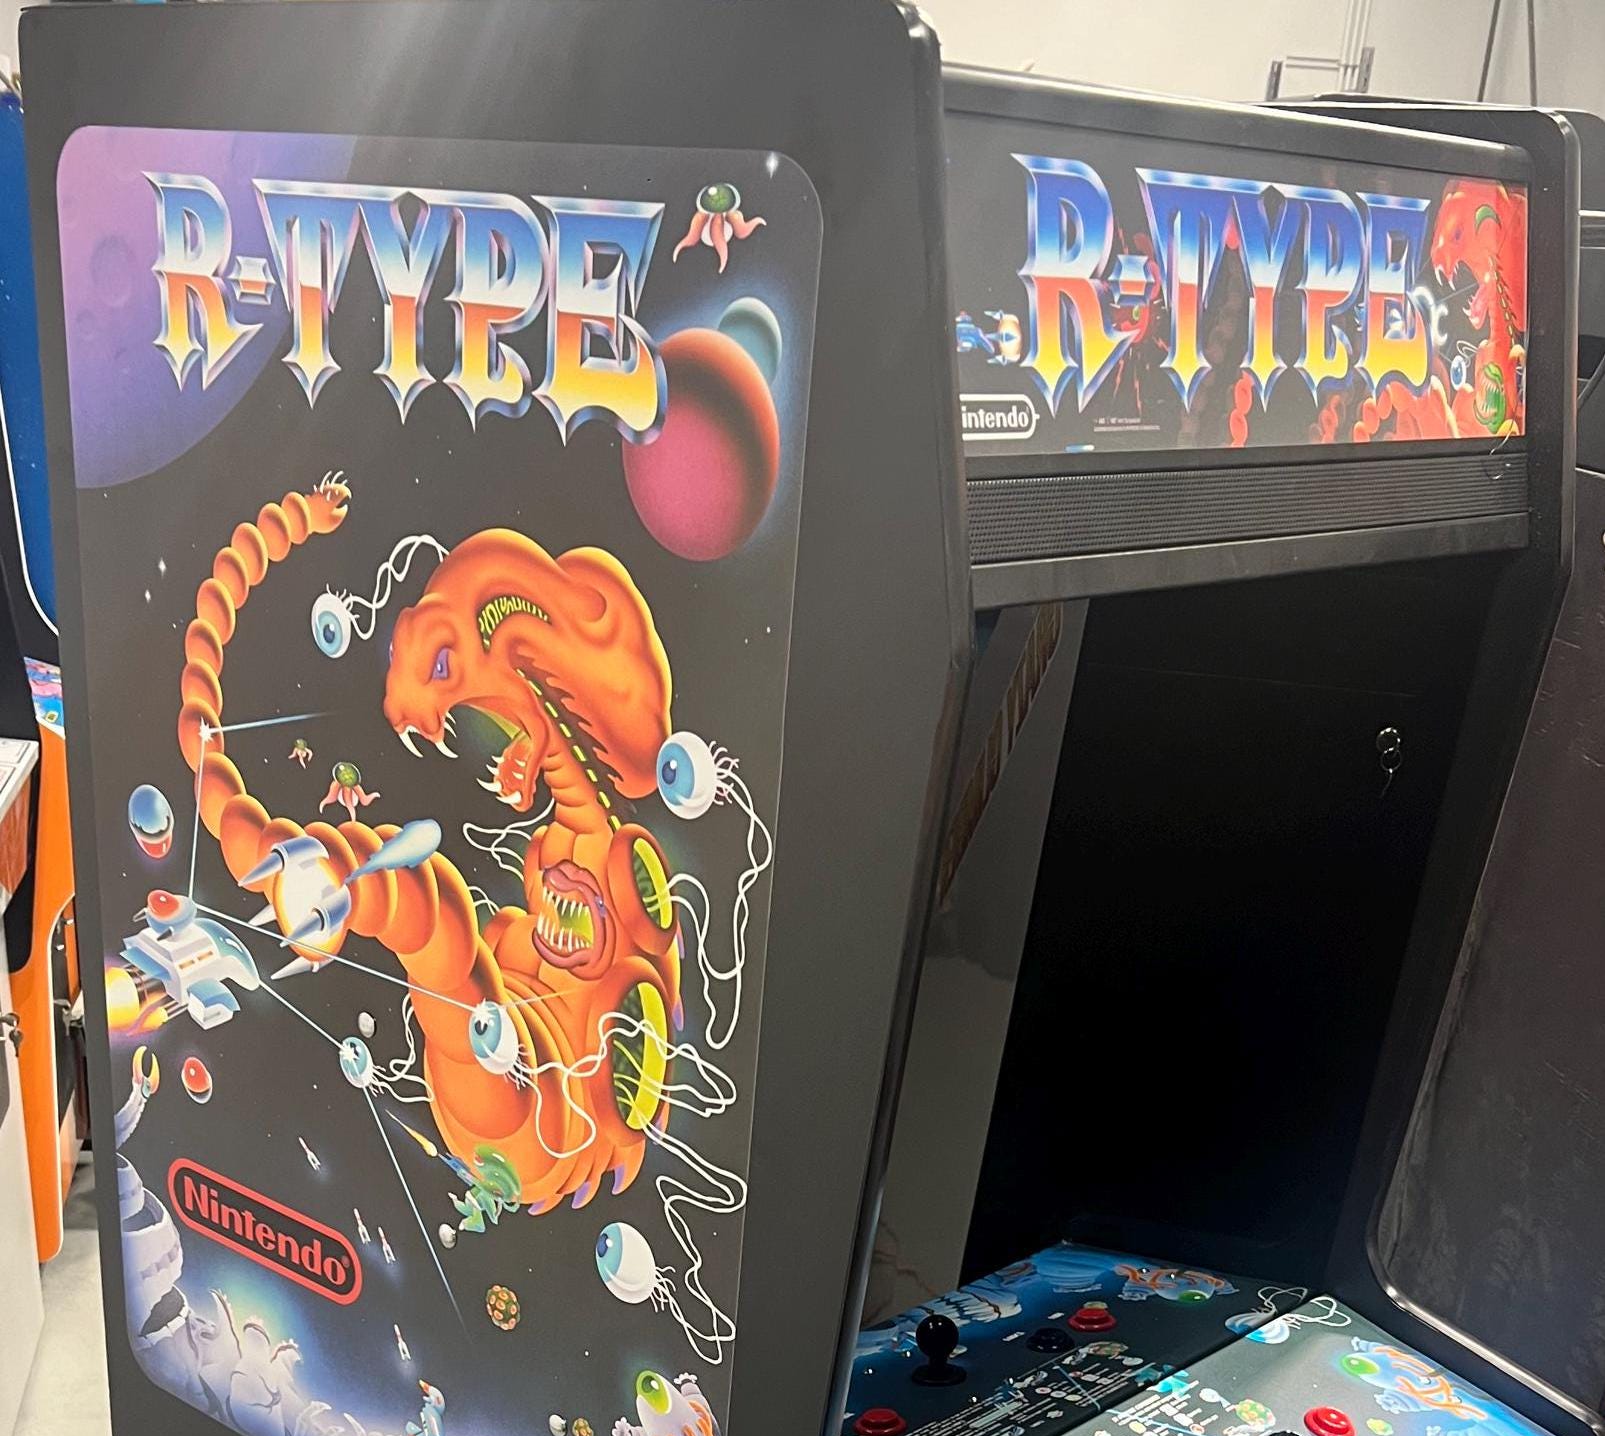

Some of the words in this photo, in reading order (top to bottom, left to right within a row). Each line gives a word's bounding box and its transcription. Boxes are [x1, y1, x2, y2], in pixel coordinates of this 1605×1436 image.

[141, 171, 667, 447] R-TYPE
[1010, 152, 1435, 417] R-TYPE
[961, 404, 1030, 429] intendo
[183, 1175, 347, 1286] Nintendo
